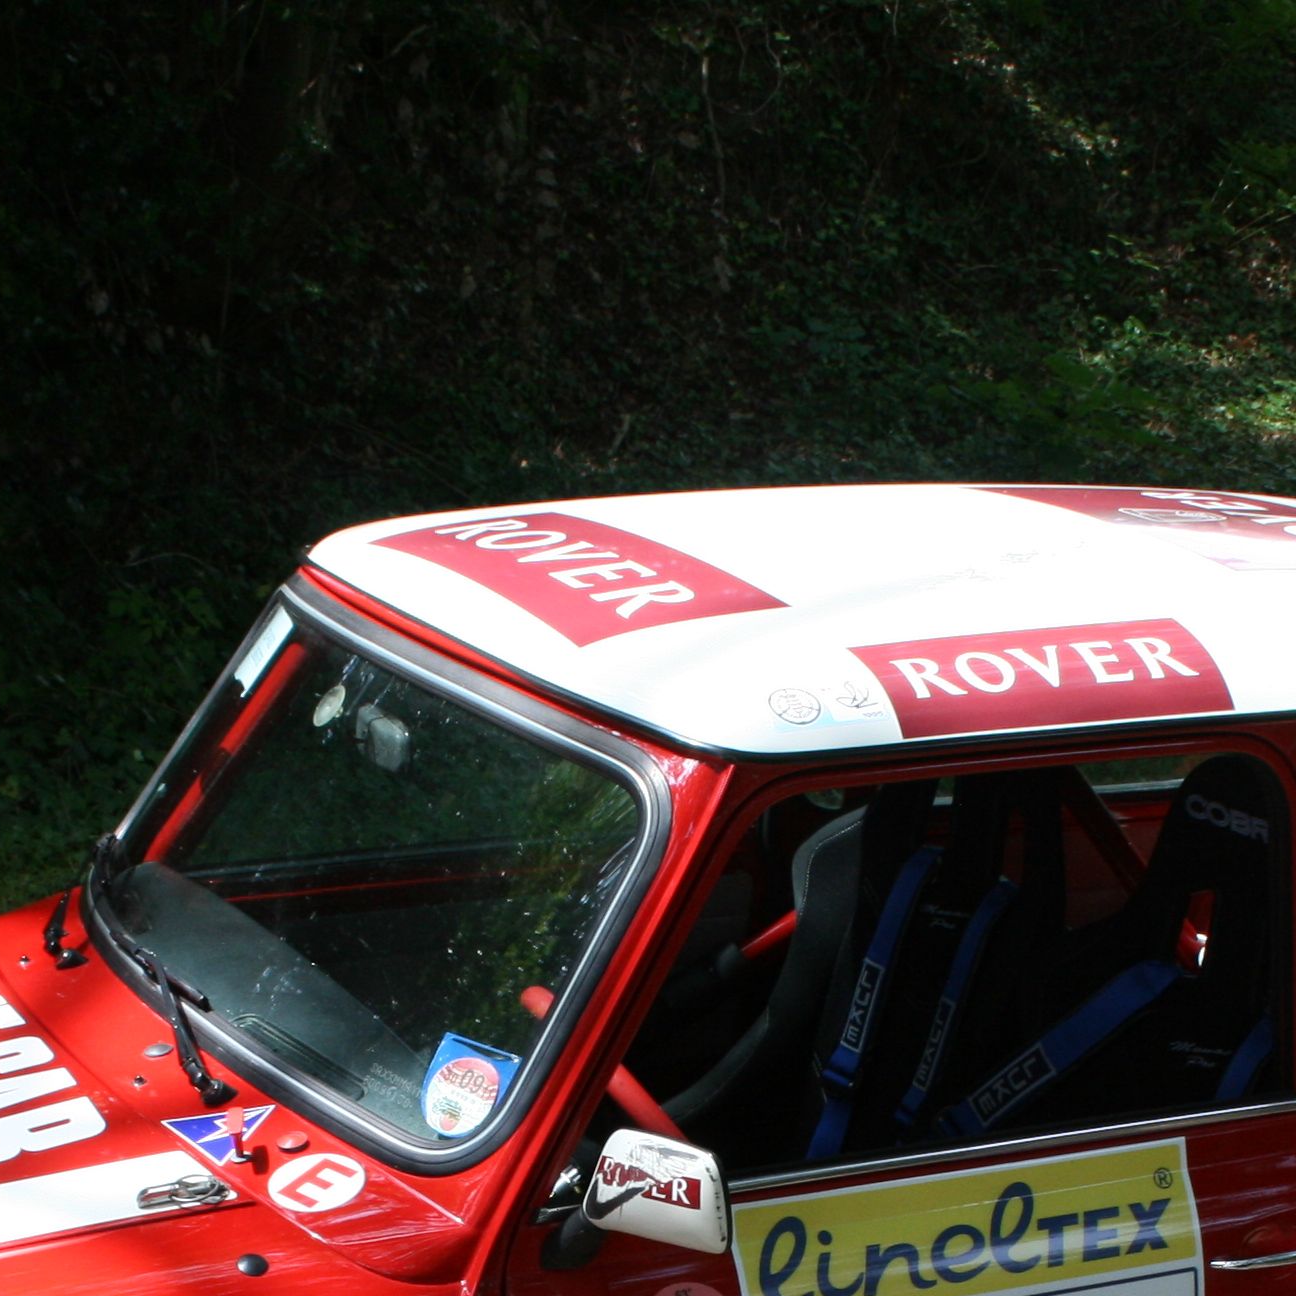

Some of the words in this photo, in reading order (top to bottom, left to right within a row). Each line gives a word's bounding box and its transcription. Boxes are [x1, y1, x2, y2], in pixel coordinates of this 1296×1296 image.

[434, 518, 695, 620] ROVER
[889, 634, 1201, 703] ROVER
[1185, 793, 1270, 845] COBR
[276, 1157, 359, 1209] E
[602, 1156, 691, 1206] ROER
